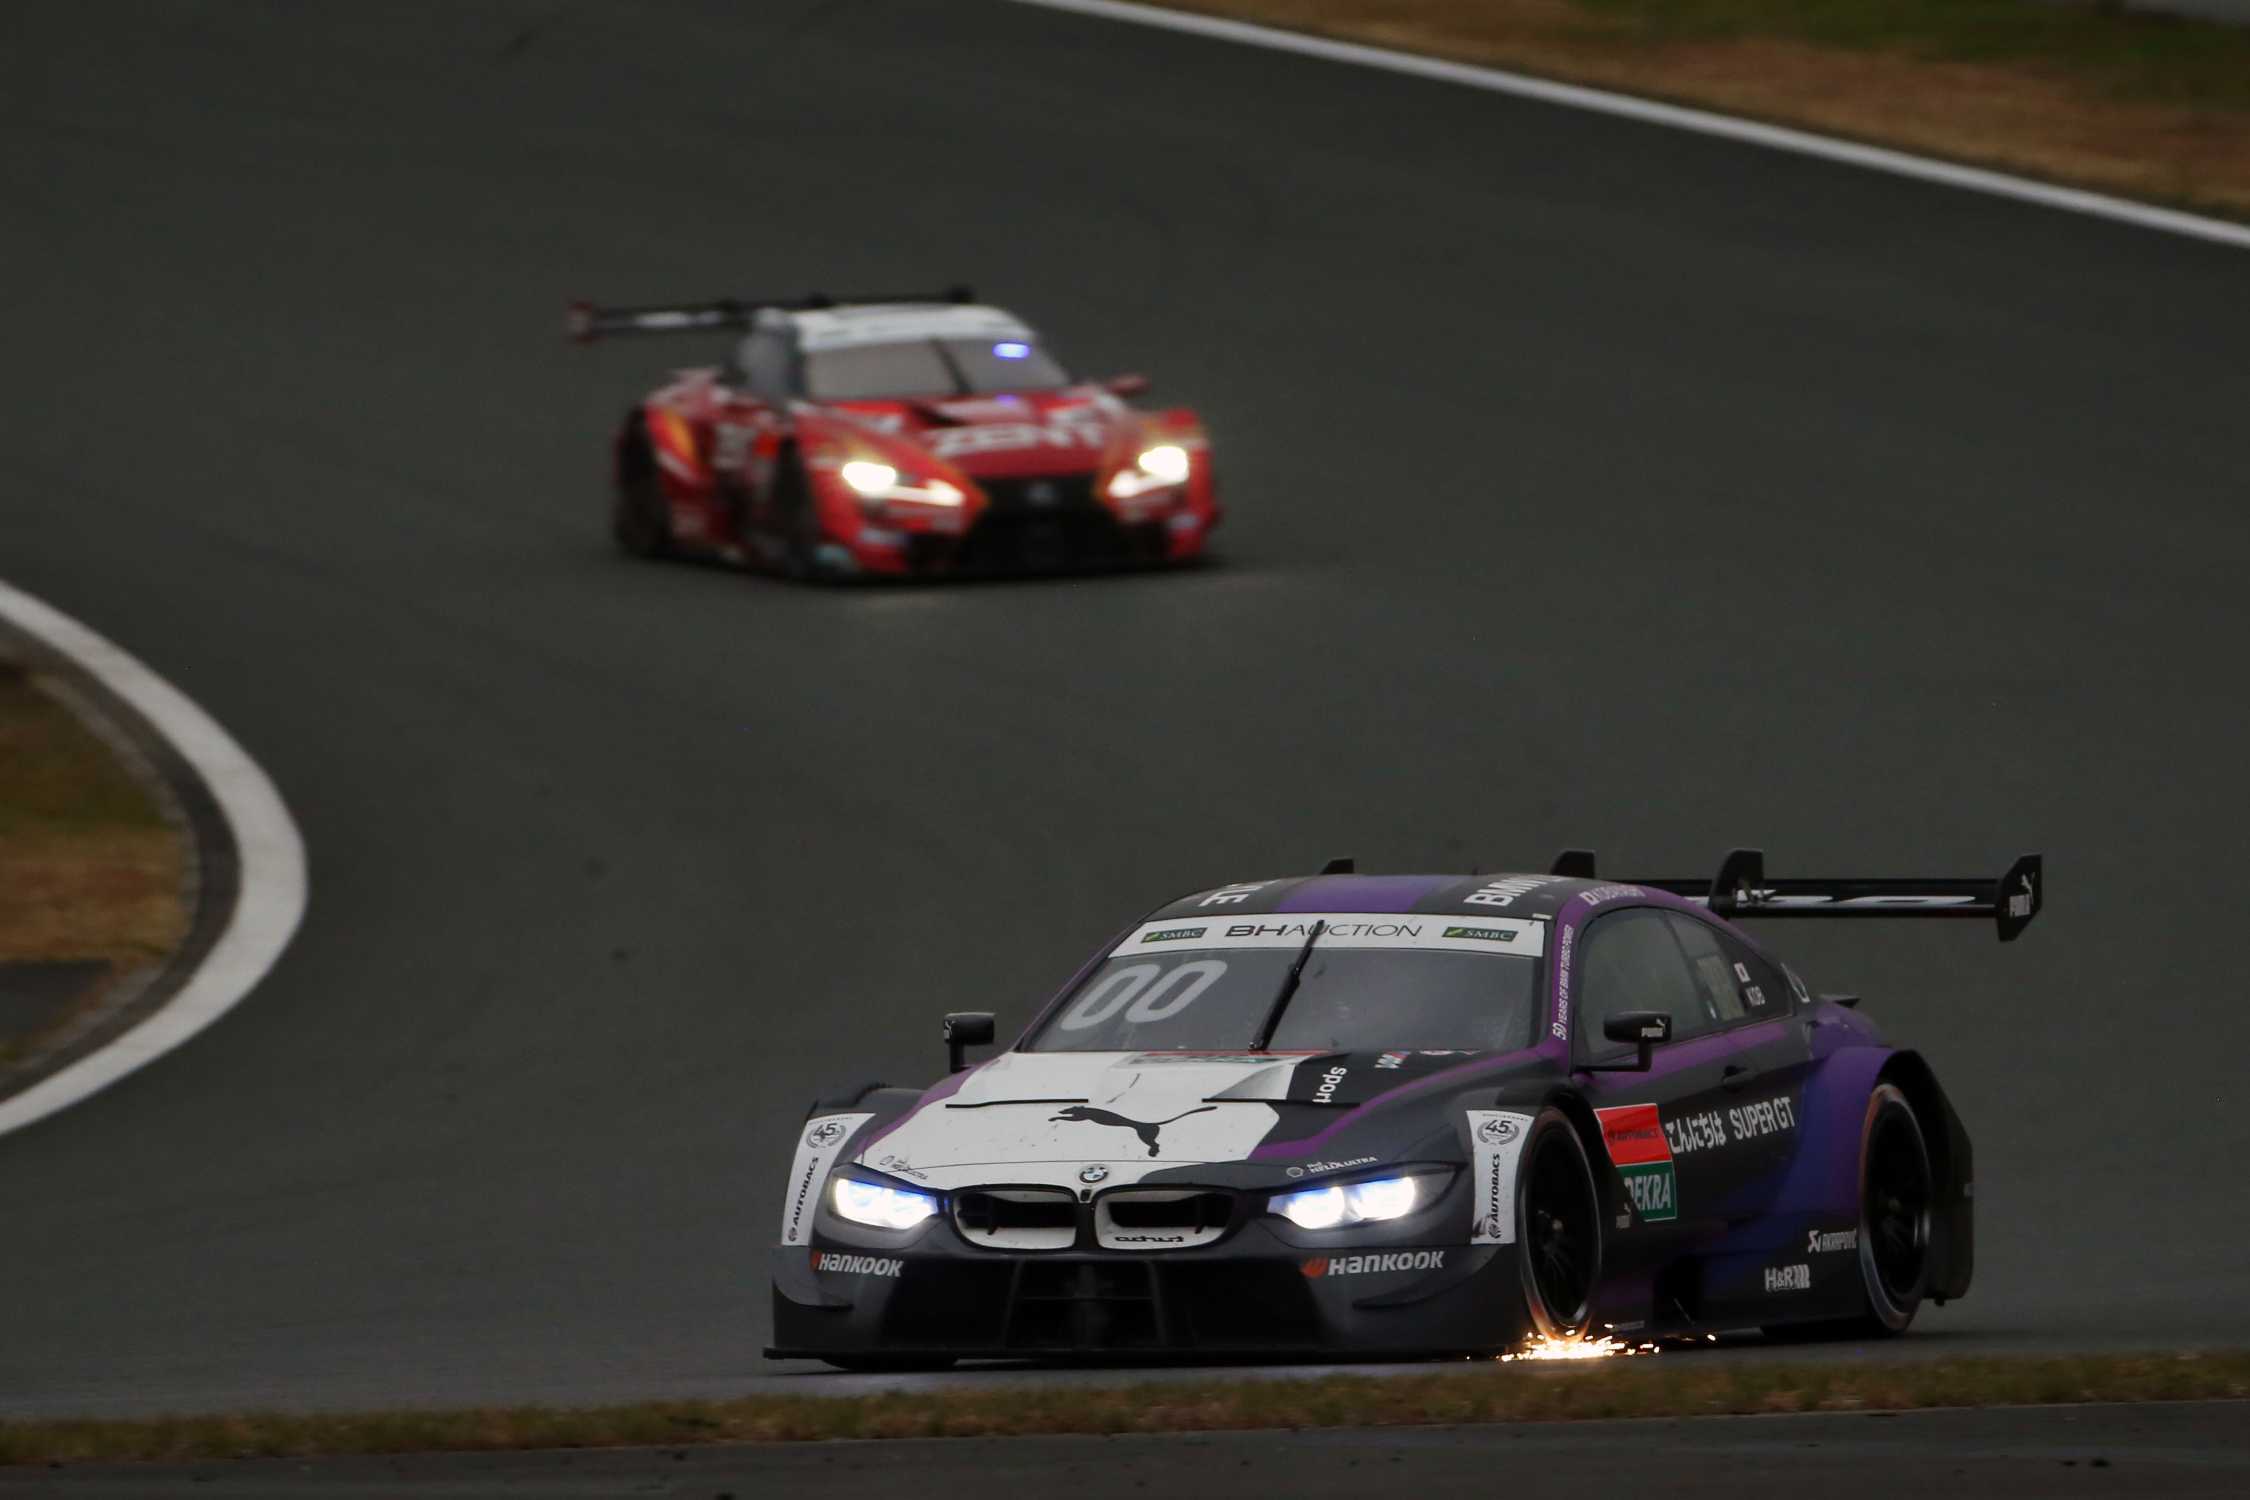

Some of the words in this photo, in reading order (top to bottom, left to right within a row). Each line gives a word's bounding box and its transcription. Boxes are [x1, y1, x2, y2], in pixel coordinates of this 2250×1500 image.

[1161, 929, 1202, 940] SMBC
[1467, 930, 1512, 941] SMBC
[1060, 960, 1228, 1031] 00
[1552, 1022, 1567, 1041] 50
[1312, 1066, 1348, 1104] sport
[812, 1122, 838, 1140] 45
[1484, 1119, 1512, 1134] 45
[1665, 1110, 1727, 1154] こんにちは
[1730, 1101, 1778, 1140] SUPER
[1774, 1096, 1796, 1129] GT
[793, 1156, 819, 1227] AUTOBACS
[1490, 1153, 1500, 1224] AUTOBACS
